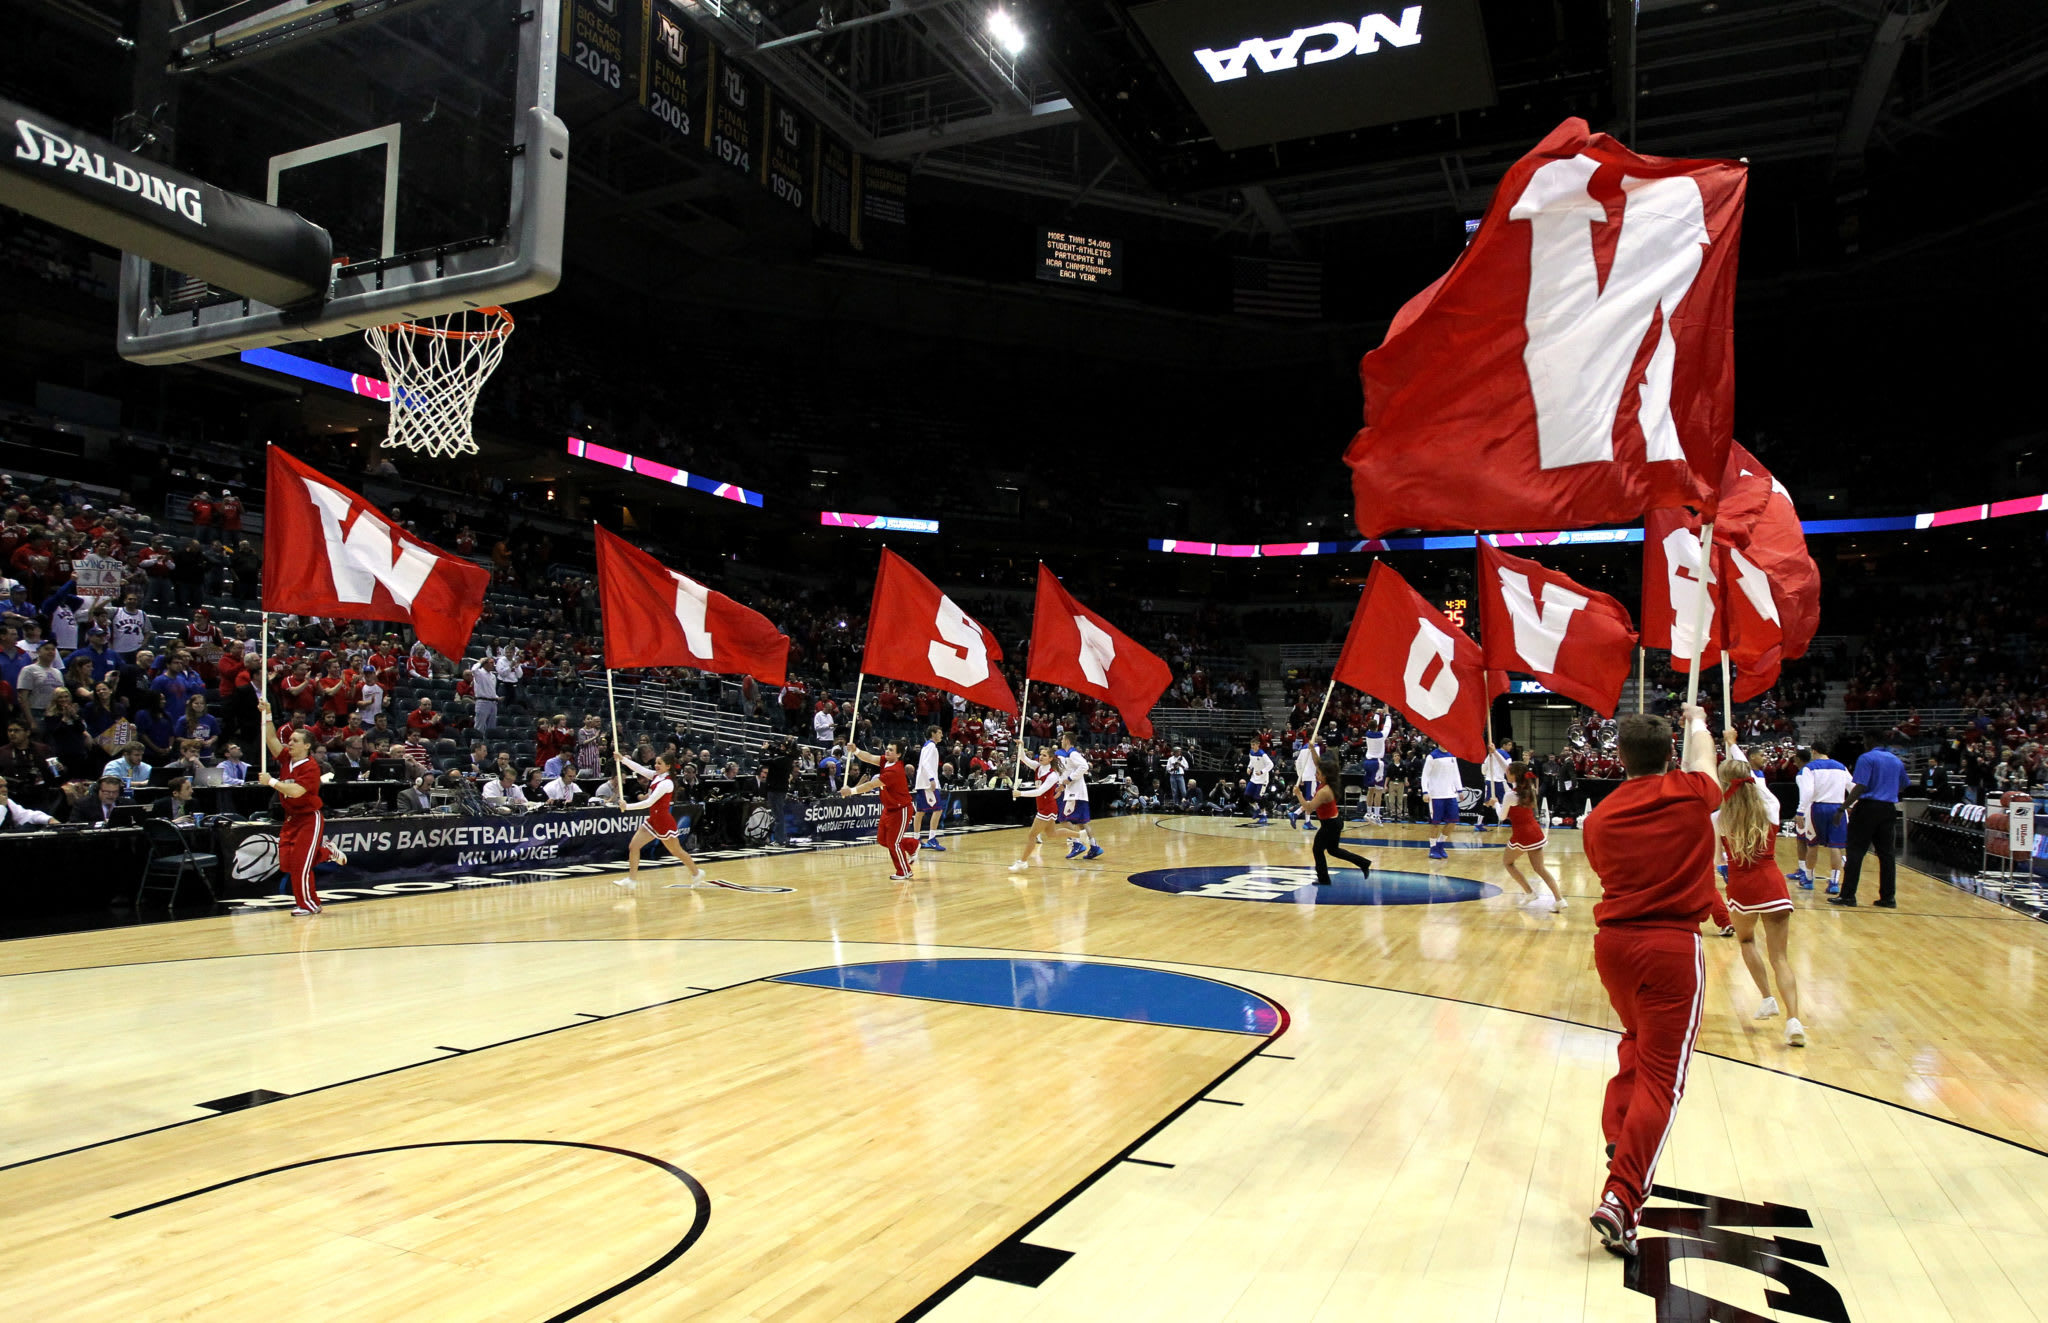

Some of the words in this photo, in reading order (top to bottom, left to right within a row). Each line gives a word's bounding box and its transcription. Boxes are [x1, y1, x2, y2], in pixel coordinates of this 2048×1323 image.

[577, 4, 596, 28] BIG
[597, 17, 622, 47] EAST
[576, 21, 622, 62] CHAMPS
[1193, 5, 1422, 83] NCAA
[575, 41, 621, 89] 2013
[655, 59, 687, 93] FINAL
[654, 74, 688, 108] FOUR
[651, 91, 690, 136] 2003
[717, 104, 749, 135] FINAL
[717, 118, 749, 148] FOUR
[713, 134, 750, 173] 1974
[16, 119, 203, 226] SPALDING
[771, 172, 802, 208] 1970
[1047, 232, 1065, 241] MORE
[1068, 235, 1085, 244] THAN
[1088, 238, 1111, 249] 54,000
[1047, 241, 1111, 258] STUDENT-ATHLETES
[1046, 258, 1062, 268] NCAA
[1065, 261, 1112, 276] CHAMPIONSHIPS
[1054, 250, 1095, 264] PARTICIPATE
[1097, 258, 1104, 266] IN
[1060, 269, 1076, 279] EACH
[104, 561, 121, 570] THE
[1445, 599, 1467, 610] 4:39
[124, 625, 140, 635] 24
[804, 804, 843, 821] SECOND
[843, 803, 866, 818] AND
[867, 803, 884, 816] THI
[816, 820, 855, 833] MARQUETTE
[856, 818, 880, 830] UNIVE
[396, 823, 529, 850] BASKETBALL
[2019, 823, 2028, 846] Wilson
[457, 844, 559, 867] MILWAUKEE
